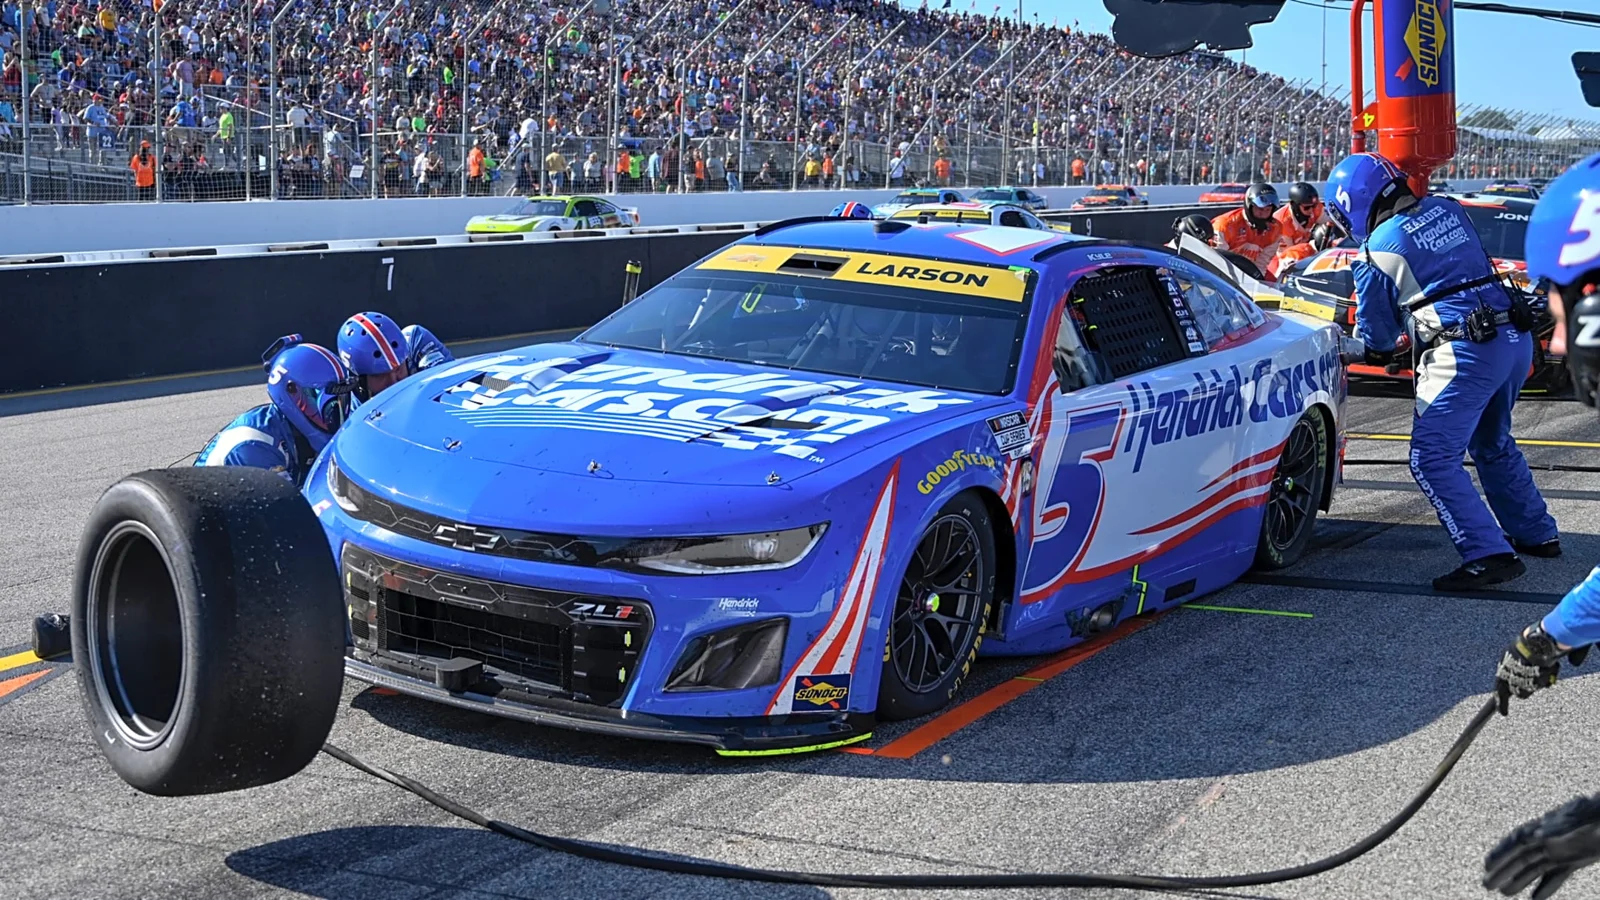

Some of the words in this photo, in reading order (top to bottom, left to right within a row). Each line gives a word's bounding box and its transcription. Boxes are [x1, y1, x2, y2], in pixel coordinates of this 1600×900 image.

[1418, 0, 1438, 83] SUNOC
[1363, 113, 1375, 127] 4
[1086, 218, 1092, 236] 9
[1402, 205, 1447, 233] HARDER
[1494, 212, 1531, 222] JON
[1412, 213, 1460, 249] Hendrick
[1429, 226, 1466, 252] Cars.com
[382, 257, 394, 291] 7
[856, 262, 989, 287] LARSON
[268, 365, 288, 385] 5
[1000, 414, 1021, 428] NASCAR
[1010, 429, 1026, 443] SERIES
[808, 455, 825, 463] TM
[917, 450, 995, 495] GOODYEAR
[1021, 401, 1126, 604] 5
[718, 598, 759, 611] Hendrick
[796, 687, 846, 701] SUNOCO
